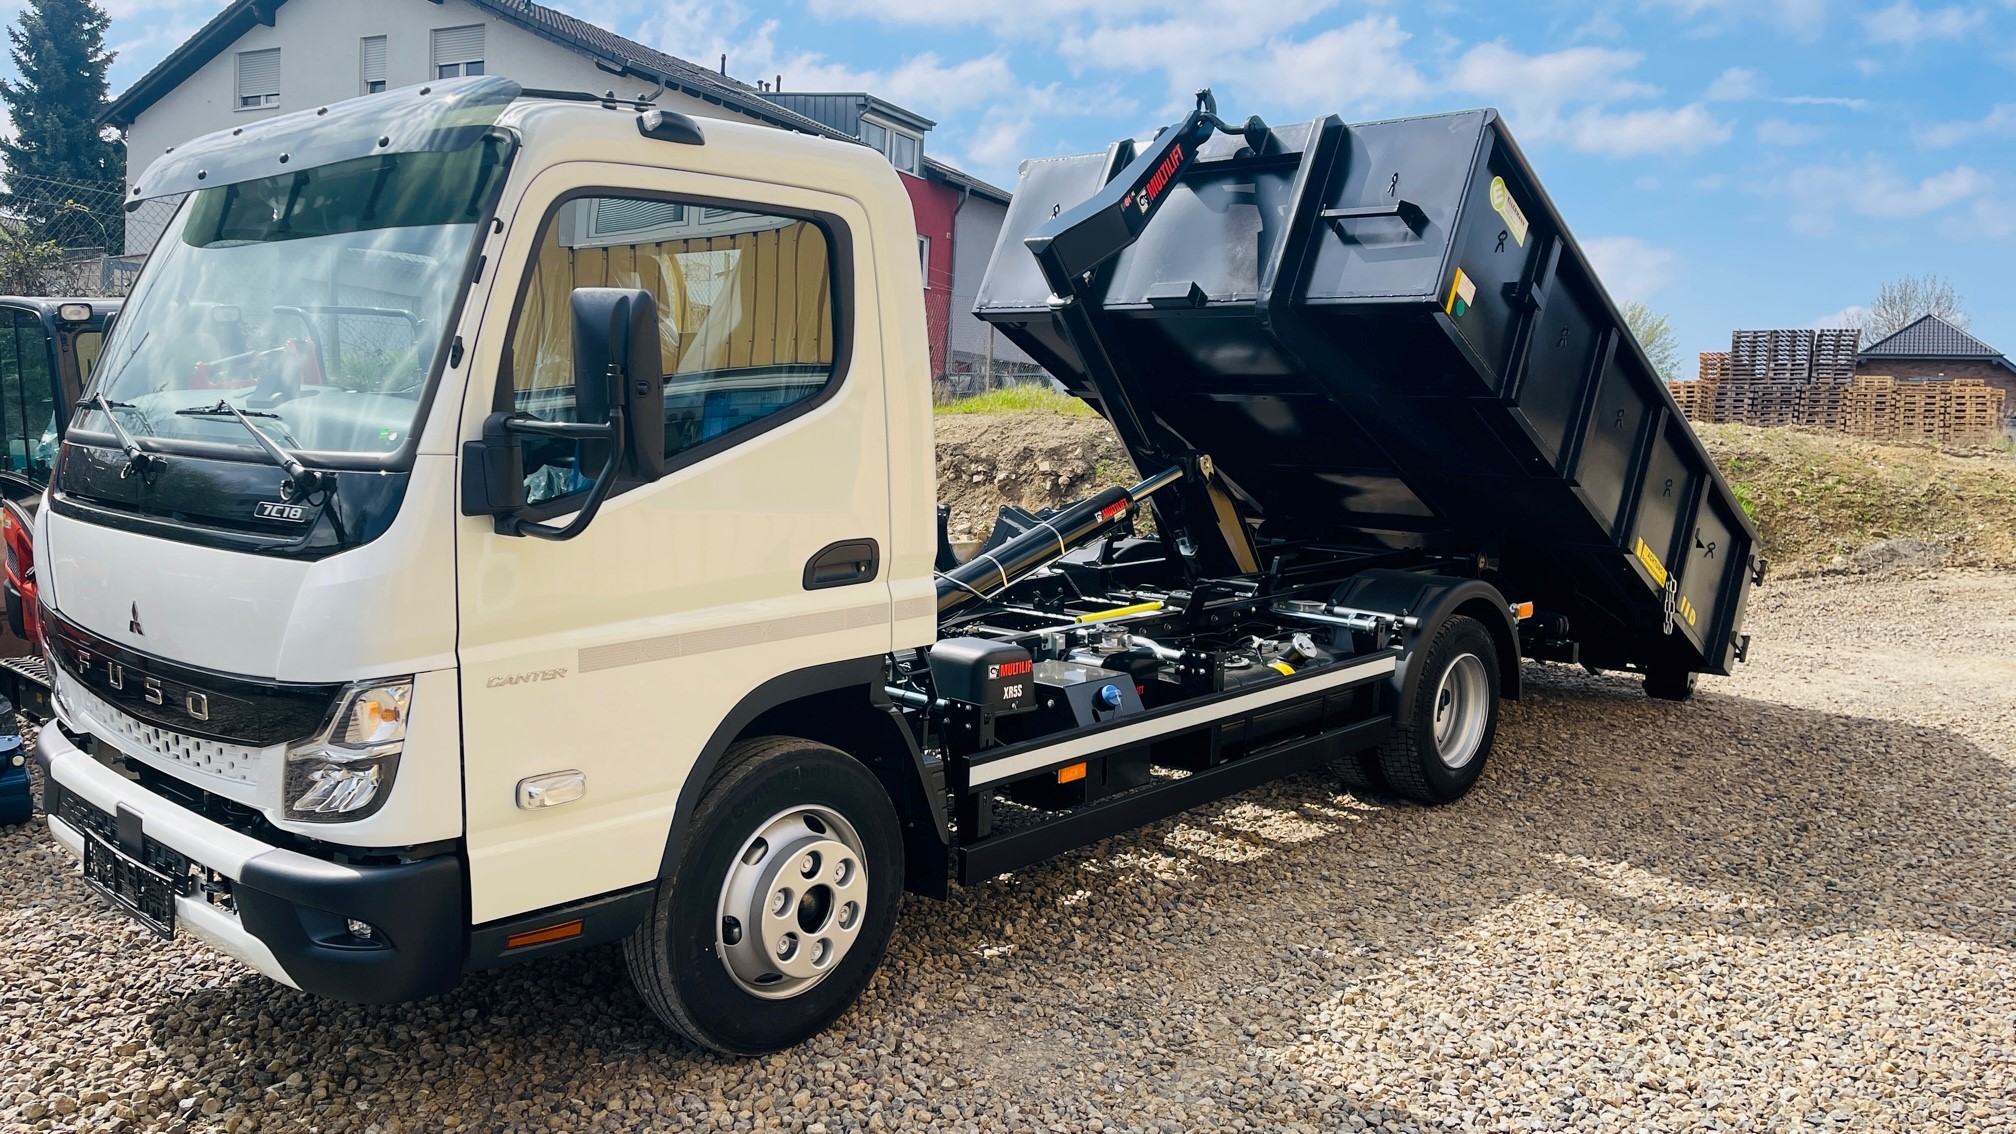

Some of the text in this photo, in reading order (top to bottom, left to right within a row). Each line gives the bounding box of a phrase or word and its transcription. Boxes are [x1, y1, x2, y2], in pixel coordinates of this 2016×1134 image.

[1146, 143, 1184, 200] MULTILIFT
[263, 504, 302, 519] 7C18
[1102, 498, 1127, 519] MULTILIFT
[78, 650, 209, 721] FUSO
[486, 667, 568, 688] CANTER
[1003, 684, 1022, 700] XR5S
